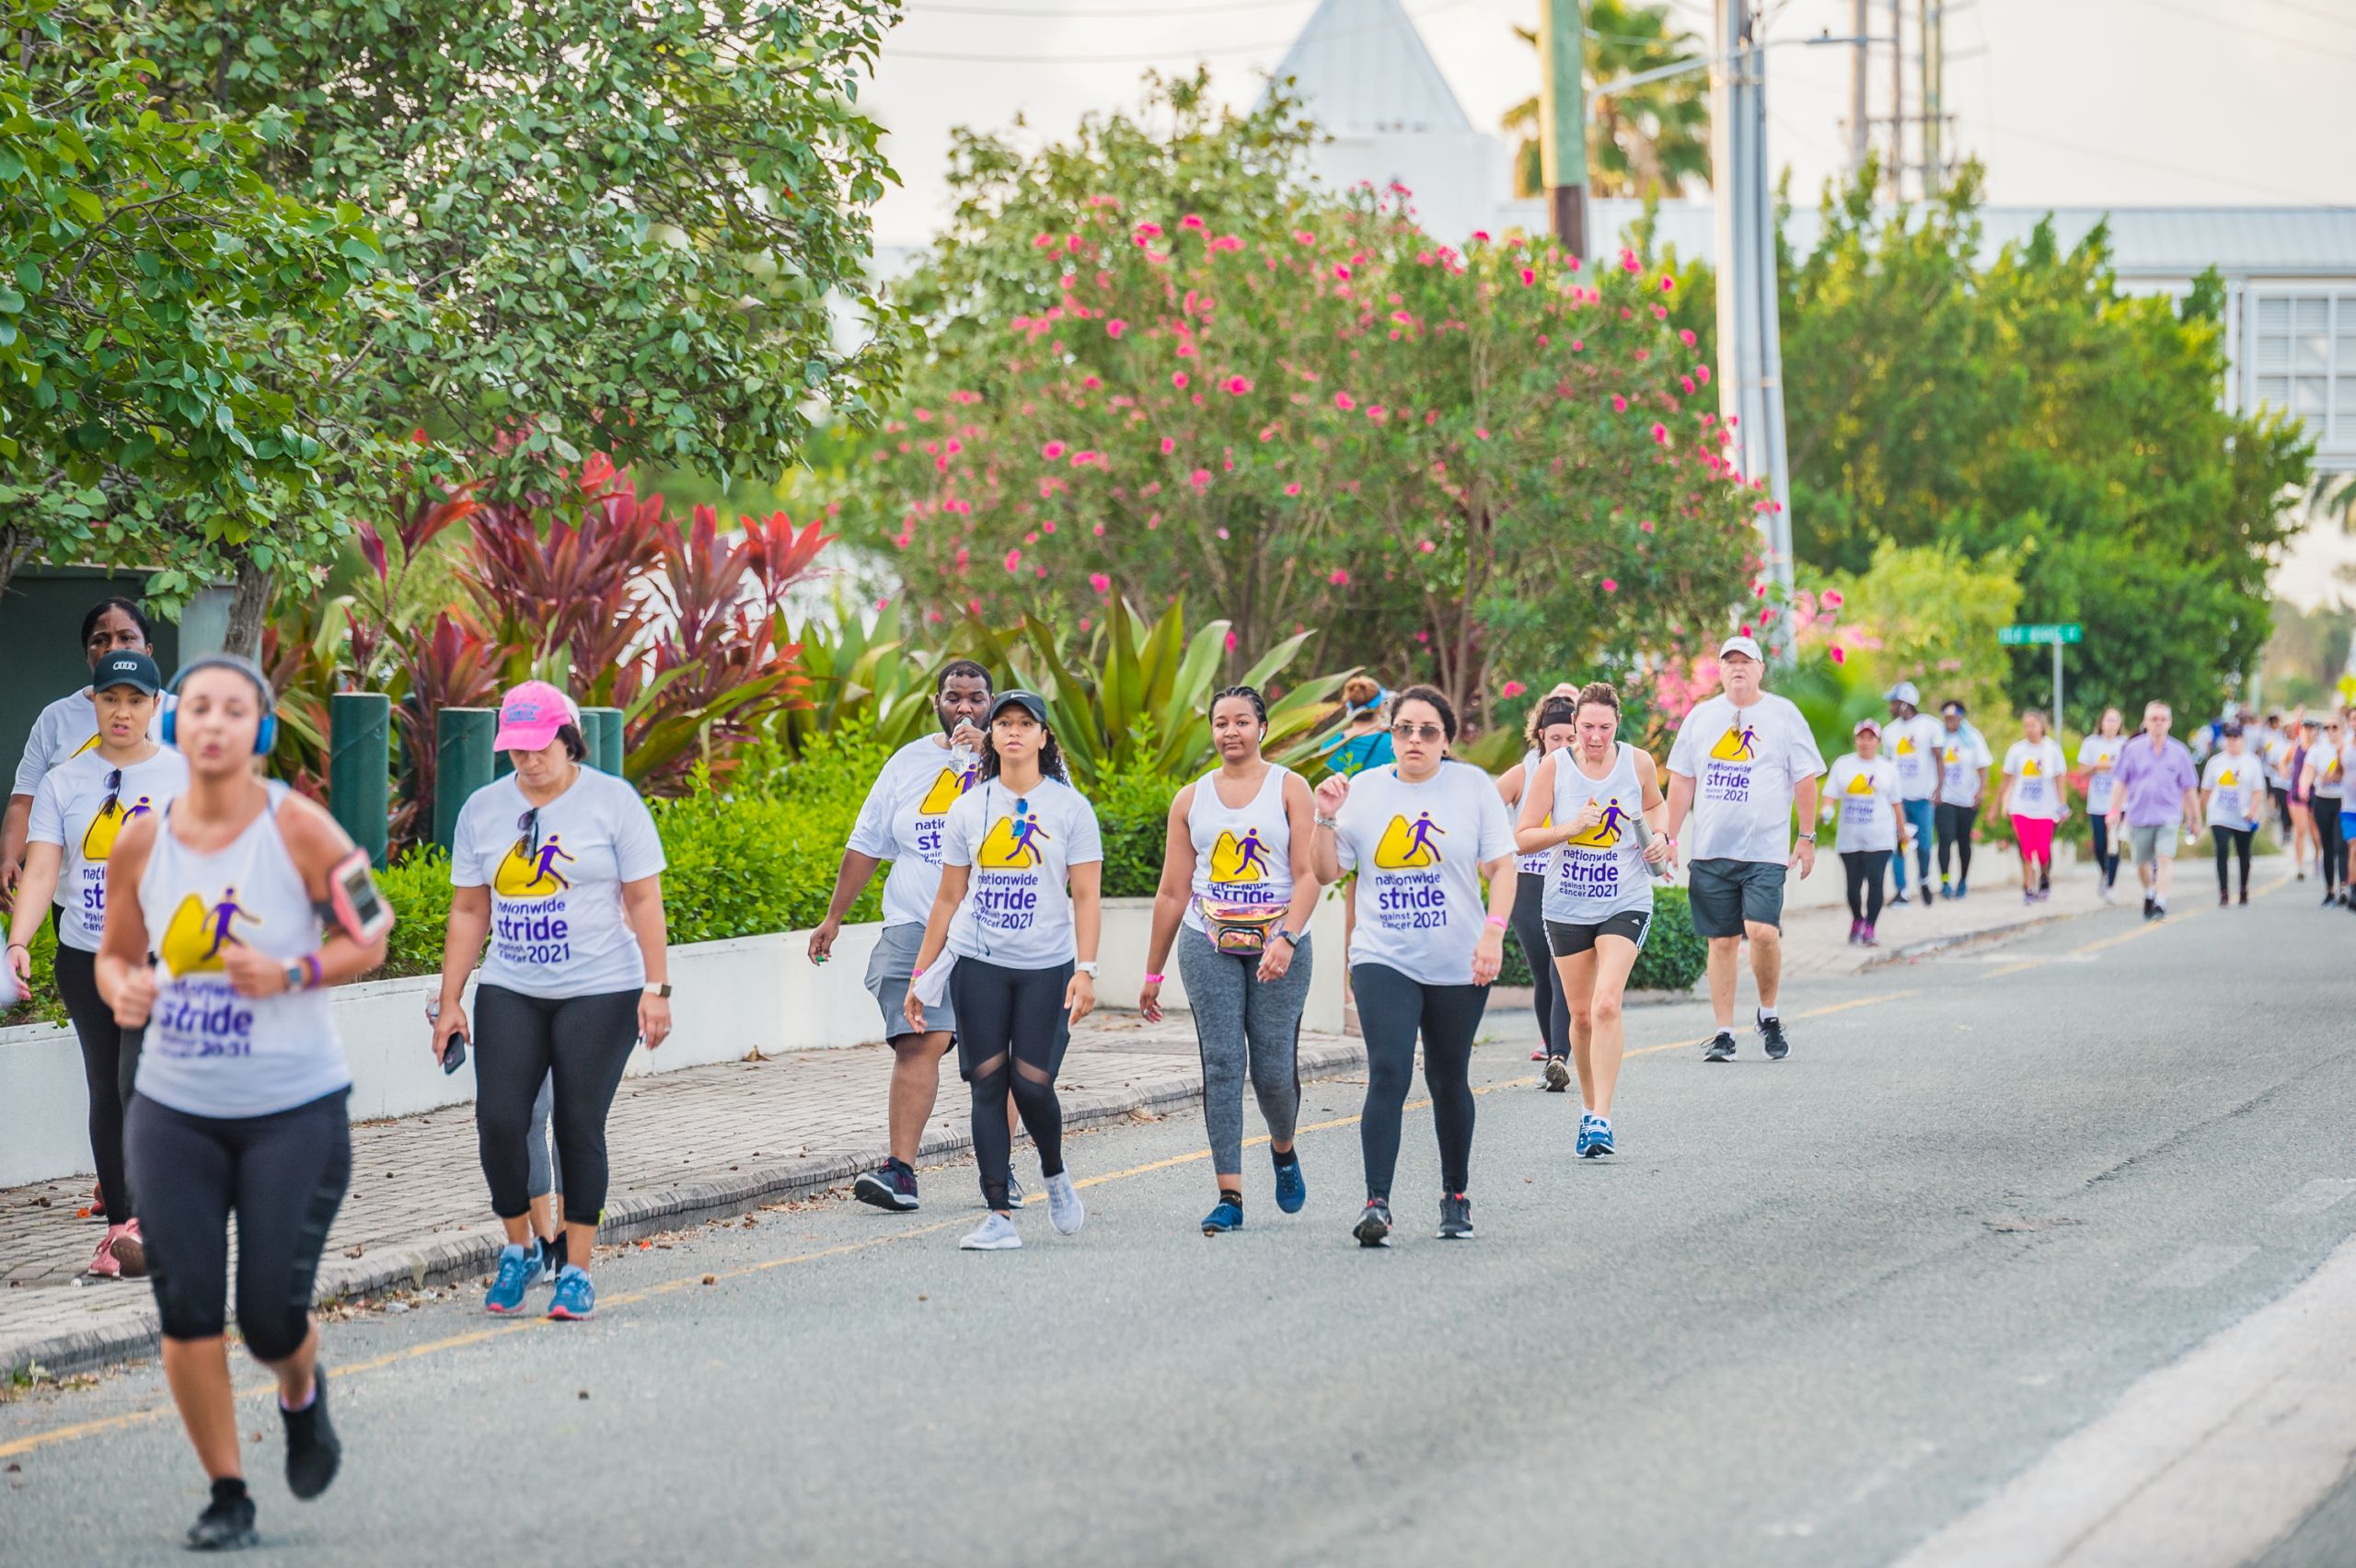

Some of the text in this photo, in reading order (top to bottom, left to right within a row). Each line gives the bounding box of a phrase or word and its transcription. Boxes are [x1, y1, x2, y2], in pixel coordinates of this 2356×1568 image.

[1707, 763, 1752, 774] nationwide
[1706, 771, 1750, 789] stride
[1723, 789, 1749, 802] 2021
[1563, 848, 1618, 862] nationwide
[1375, 871, 1441, 886] nationwide
[1561, 861, 1619, 882] stride
[1559, 883, 1618, 898] cancer 2021
[1560, 881, 1586, 891] against
[1379, 885, 1445, 910] stride
[1000, 912, 1034, 929] 2021
[1413, 909, 1447, 928] 2021
[497, 915, 568, 941] stride
[526, 941, 571, 964] 2021
[160, 1000, 254, 1037] stride
